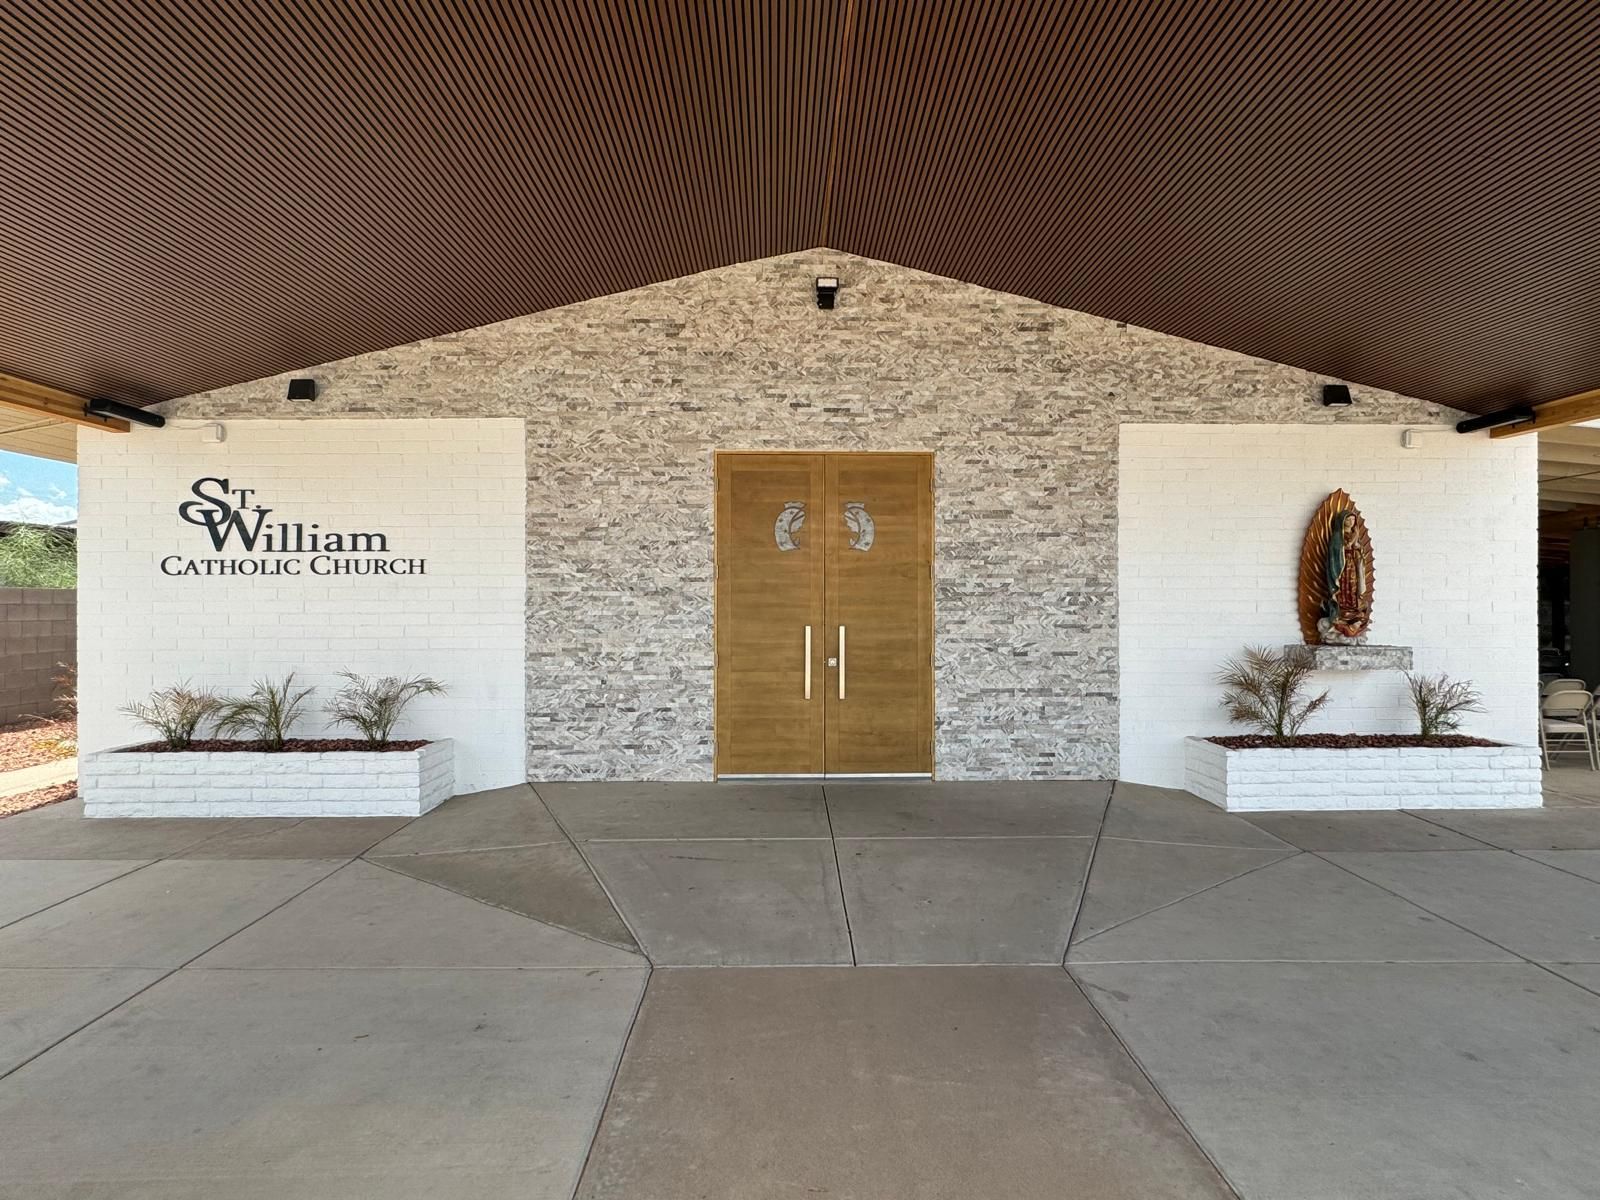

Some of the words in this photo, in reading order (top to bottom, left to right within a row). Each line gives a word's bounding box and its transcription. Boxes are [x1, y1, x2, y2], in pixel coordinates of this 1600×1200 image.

[196, 509, 390, 553] William
[160, 555, 301, 576] CATHOLIC
[309, 555, 427, 576] CHURCH
